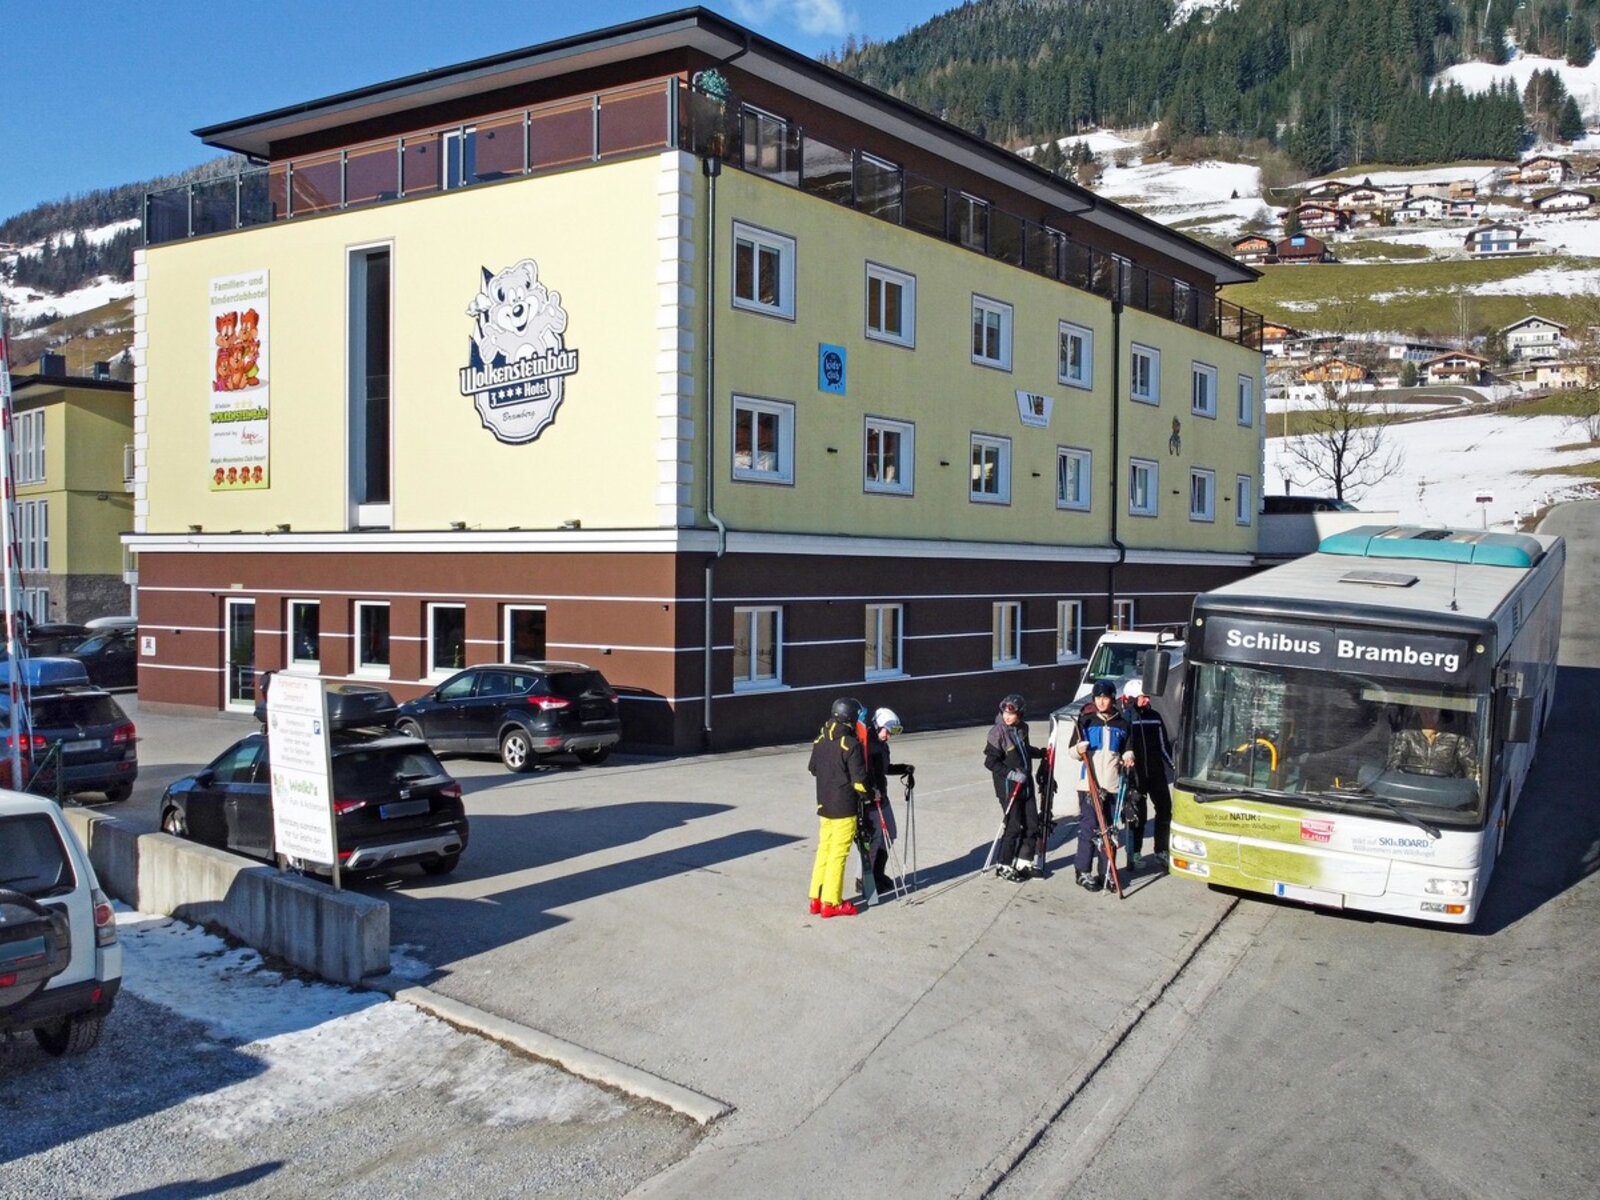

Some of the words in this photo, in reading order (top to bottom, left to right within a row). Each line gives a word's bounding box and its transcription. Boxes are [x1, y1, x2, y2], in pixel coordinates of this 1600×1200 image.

[248, 275, 264, 286] und
[460, 349, 577, 394] Wolkensteinbär
[523, 378, 550, 397] Hotel
[1226, 628, 1321, 655] Schibus
[1337, 638, 1460, 673] Bramberg
